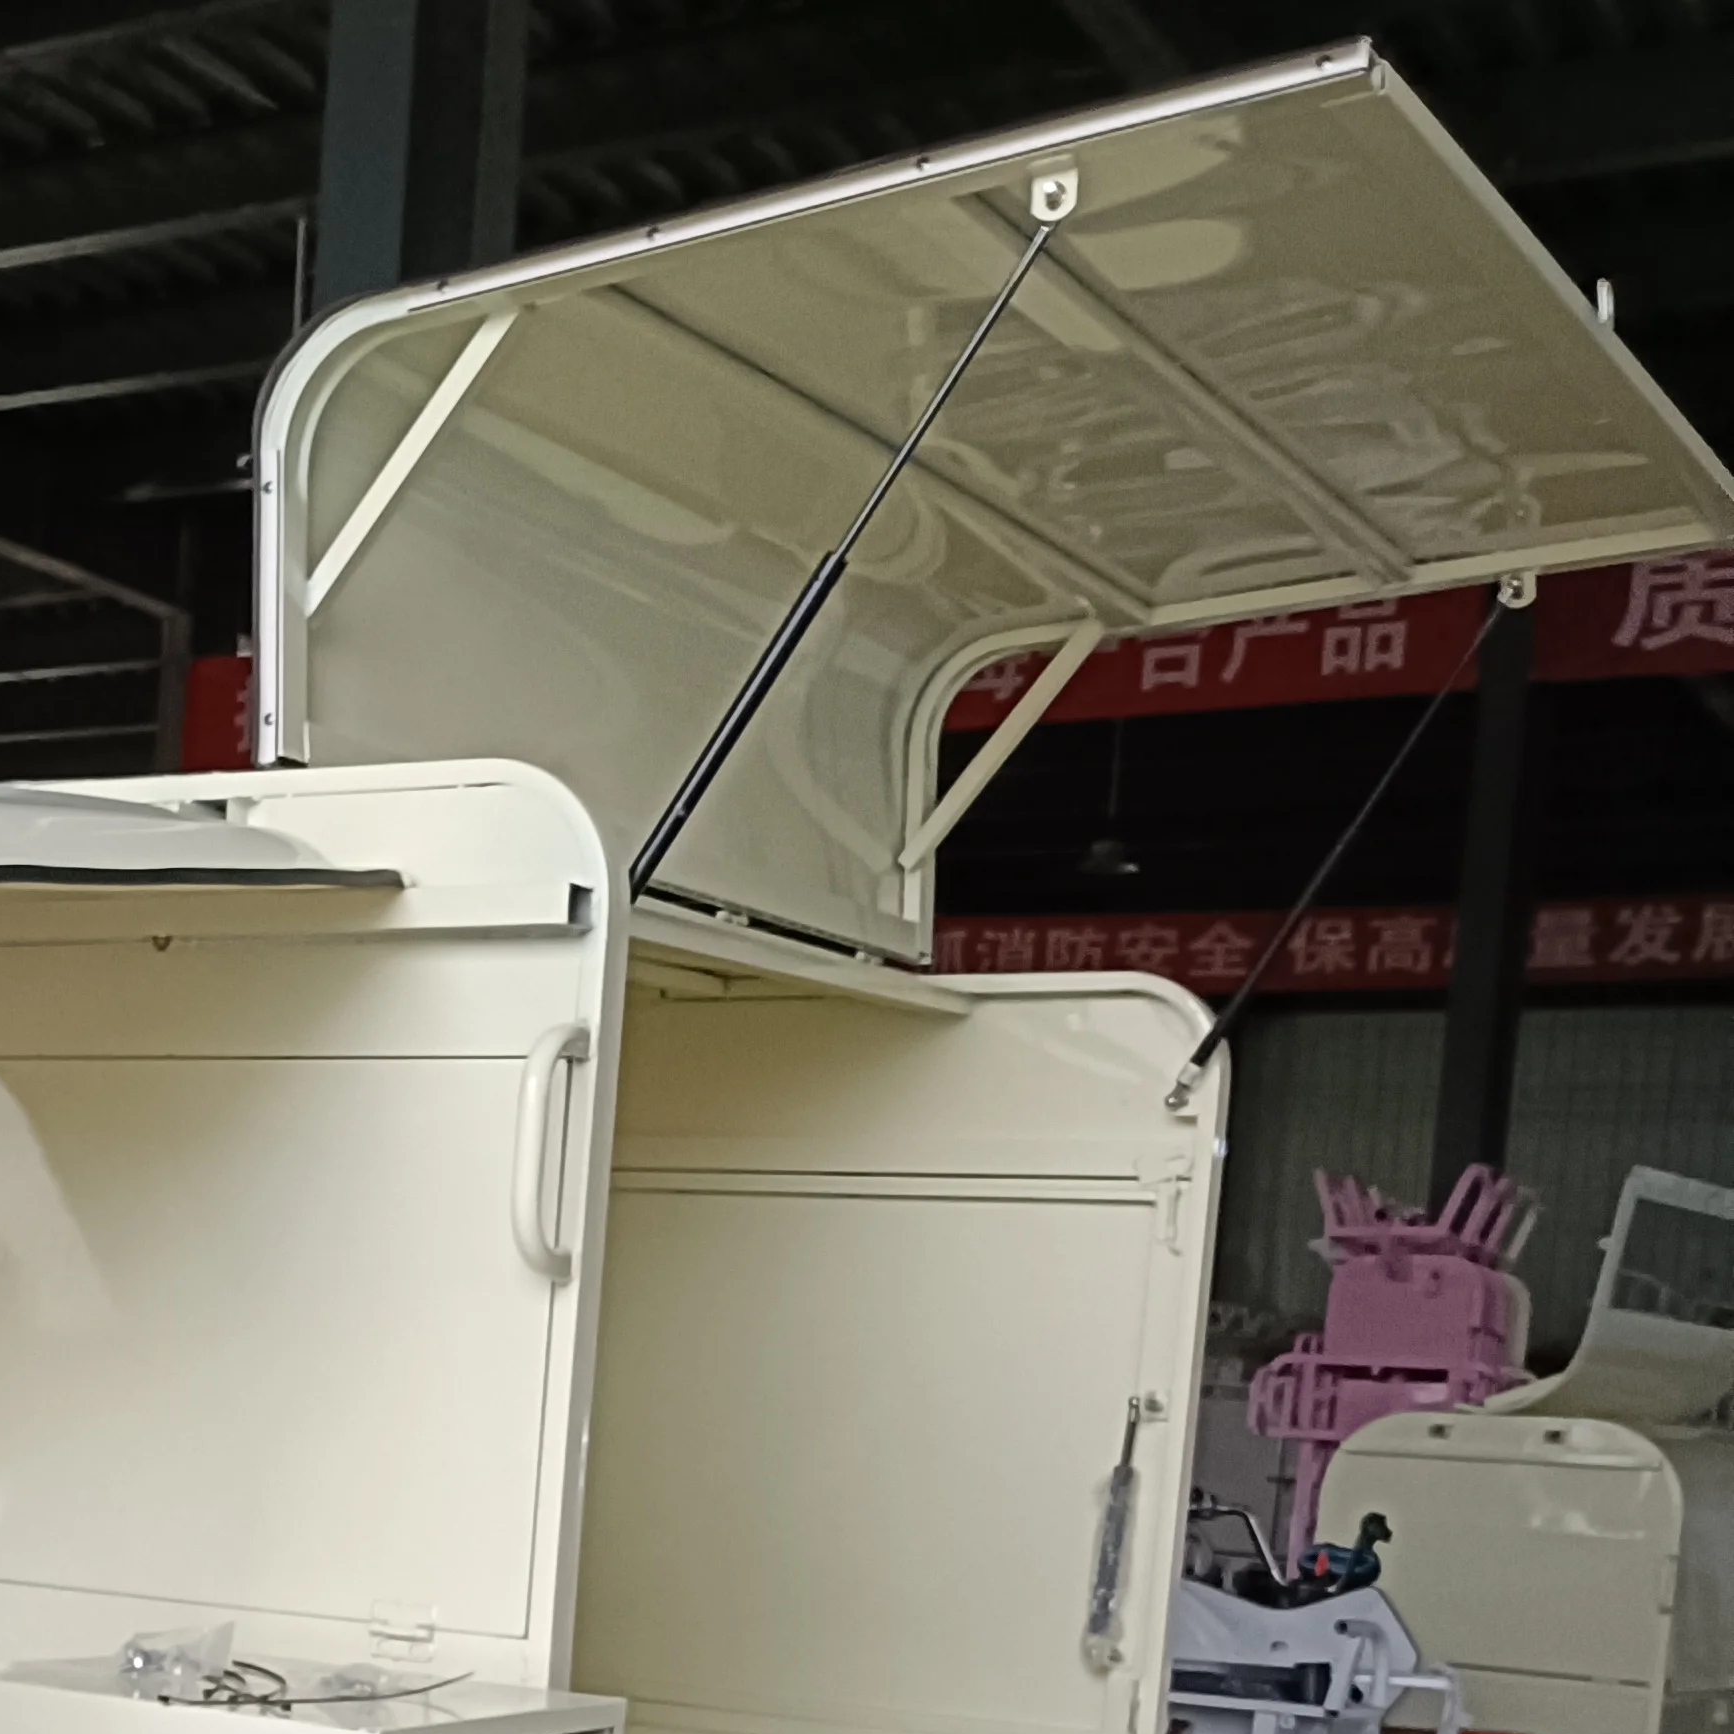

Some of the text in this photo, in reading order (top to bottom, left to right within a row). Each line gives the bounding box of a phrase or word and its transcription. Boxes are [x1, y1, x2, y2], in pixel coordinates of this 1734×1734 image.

[1286, 902, 1734, 975] 保高量发展
